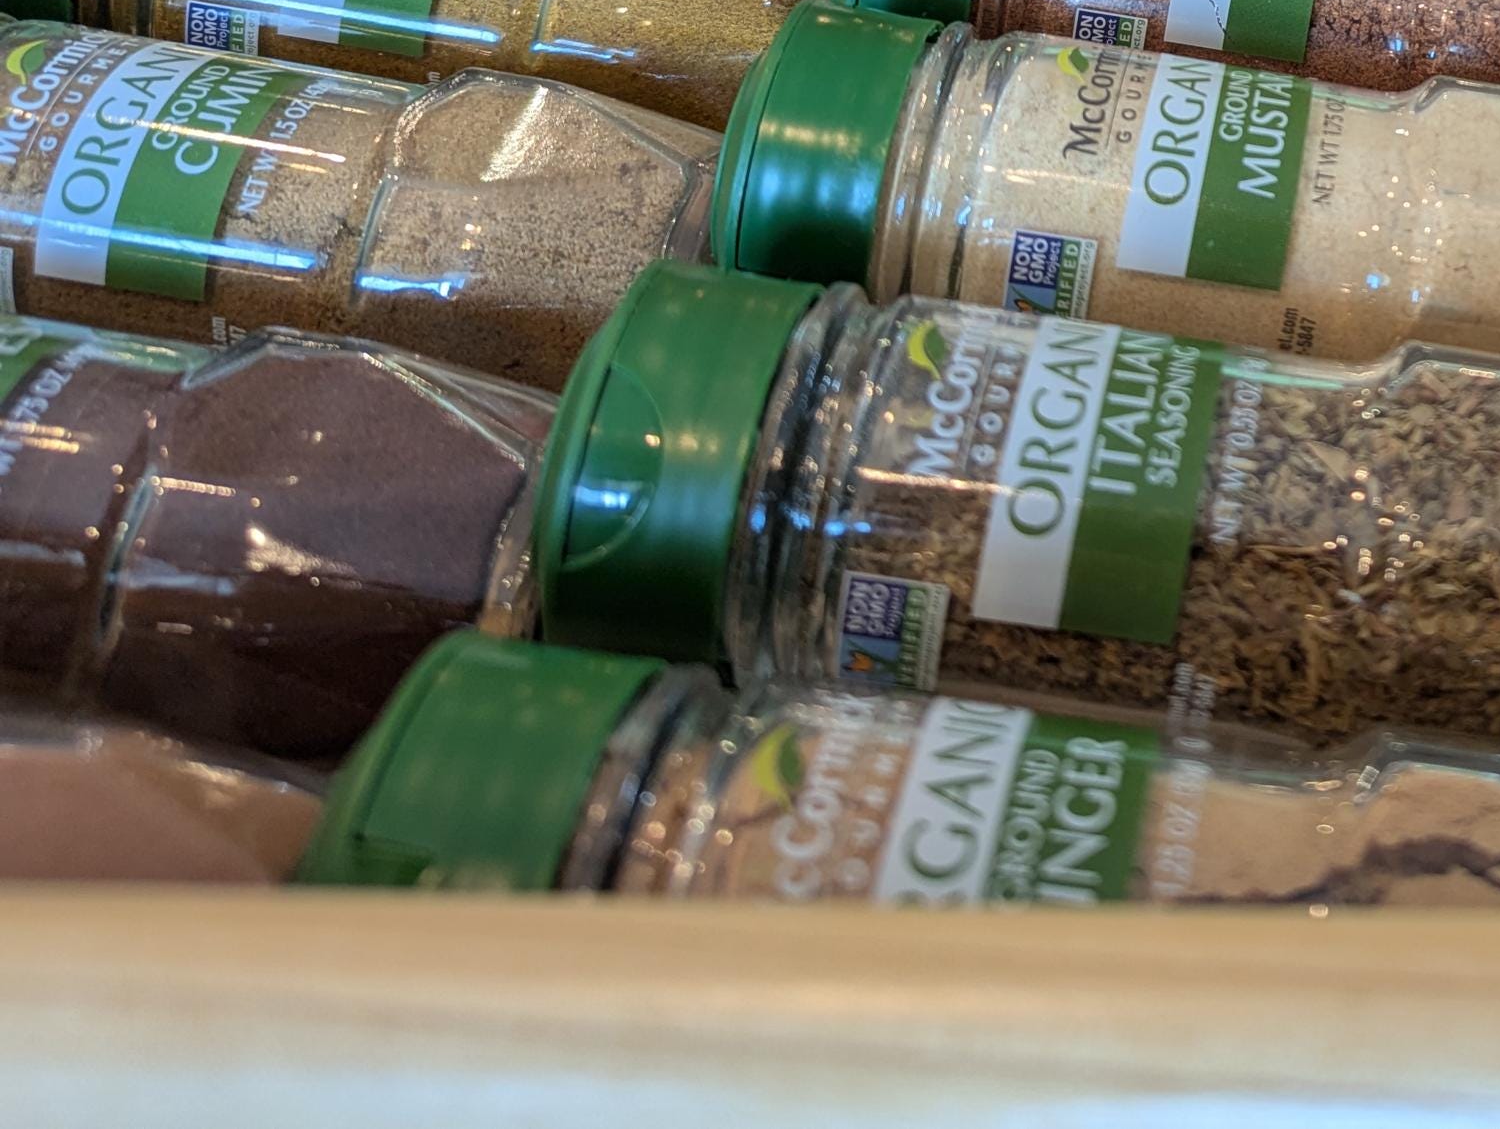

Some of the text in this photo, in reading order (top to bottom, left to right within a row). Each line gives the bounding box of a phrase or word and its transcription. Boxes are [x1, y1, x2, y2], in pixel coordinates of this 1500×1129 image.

[191, 7, 205, 43] NON
[205, 8, 218, 47] GMO
[217, 11, 231, 50] Project
[152, 64, 230, 151] GROUND
[175, 63, 278, 176] CUMIN
[1318, 141, 1339, 168] WT
[237, 175, 268, 213] NET
[1312, 172, 1333, 205] NET
[1014, 232, 1031, 280] NON
[1029, 238, 1048, 284] GMO
[1043, 240, 1061, 287] Project
[1091, 332, 1170, 494] ITALIAN
[1148, 344, 1198, 486] SEASONING
[1221, 454, 1247, 492] WT
[1211, 496, 1243, 545] NET
